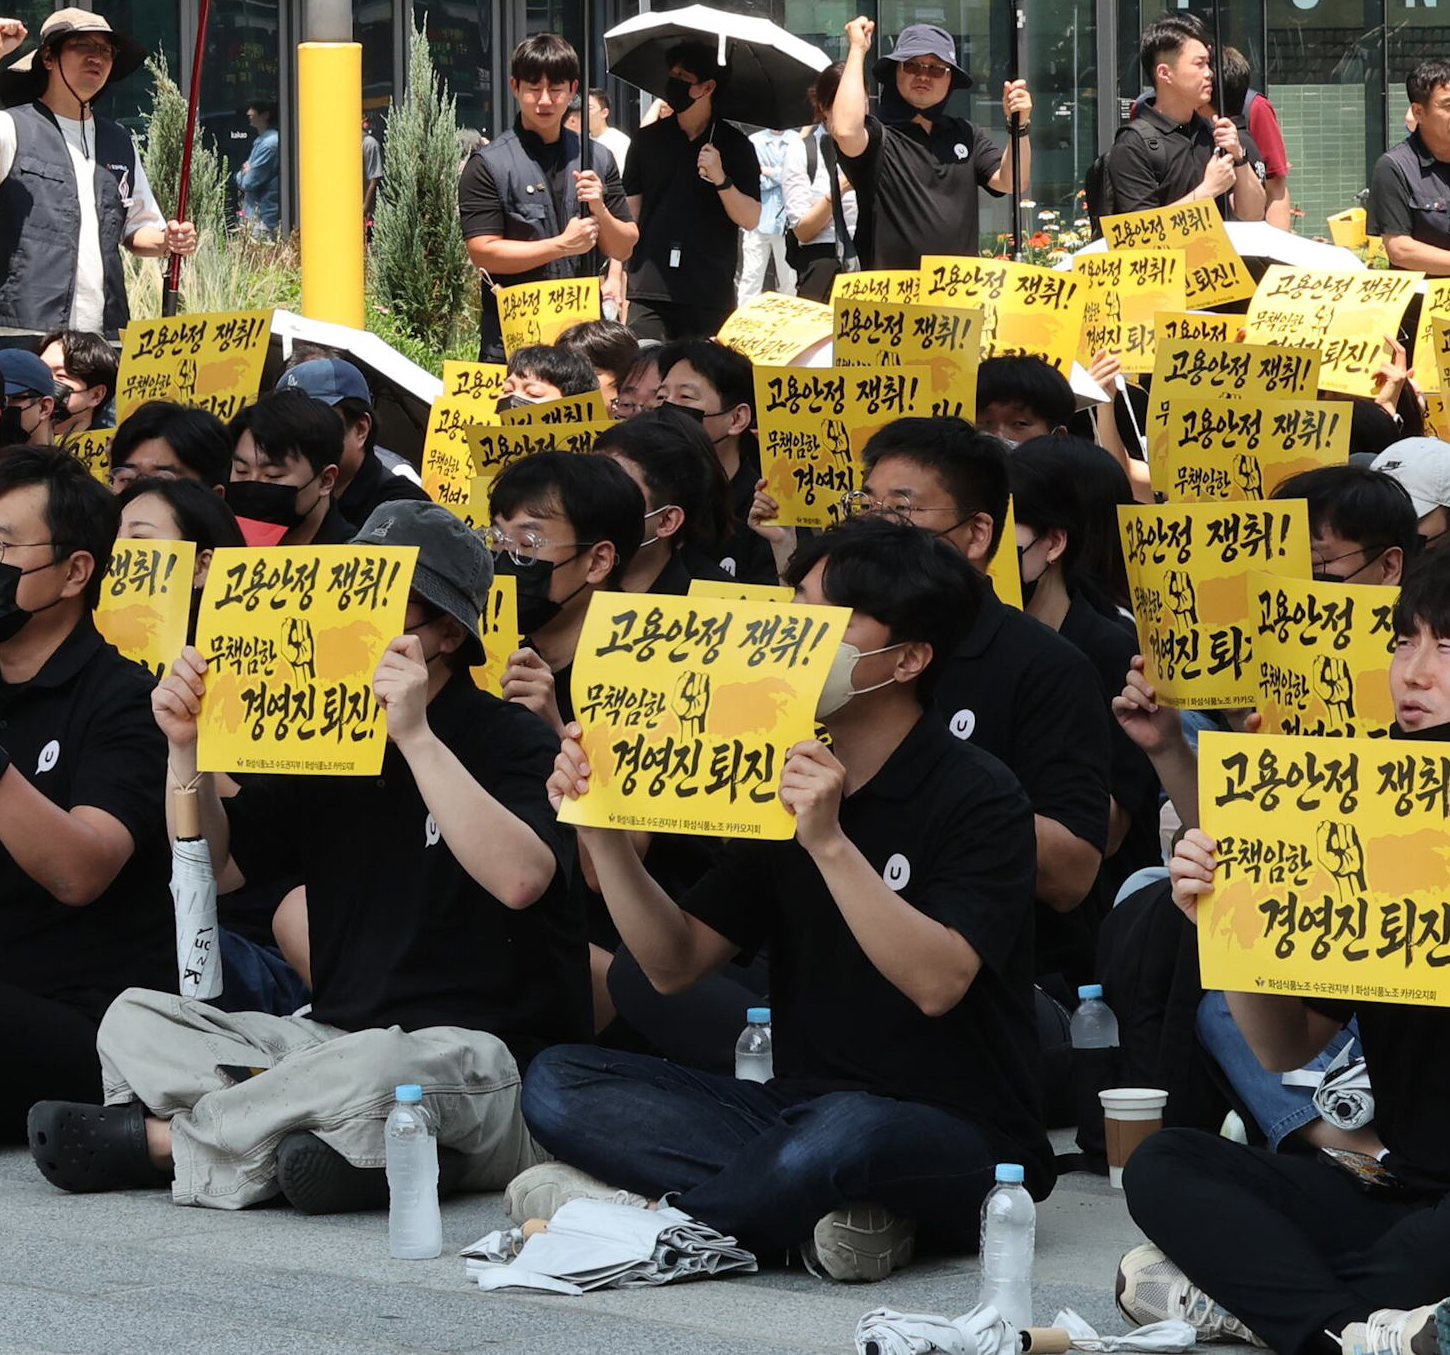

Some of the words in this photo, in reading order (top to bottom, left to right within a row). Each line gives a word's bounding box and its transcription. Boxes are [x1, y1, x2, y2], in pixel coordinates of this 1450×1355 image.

[503, 289, 540, 321] 고용안정
[549, 286, 589, 313] 쟁취!
[132, 321, 207, 360] 고용안정
[213, 318, 264, 352] 쟁취!
[766, 375, 844, 414] 고용안정
[856, 375, 918, 414] 쟁취!
[1178, 408, 1262, 450] 고용안정
[1272, 410, 1339, 450] 쟁취!
[215, 558, 320, 611] 고용안정
[327, 557, 400, 611] 쟁취!
[200, 636, 277, 681] 무책임한
[596, 607, 732, 665] 고용안정
[739, 615, 829, 668] 쟁취!
[241, 681, 316, 741] 경영진
[320, 683, 373, 743] 퇴진!
[580, 684, 665, 729] 무책임한
[612, 734, 702, 798] 경영진
[702, 735, 777, 806] 퇴진
[1215, 749, 1358, 814] 고용안정
[1210, 837, 1312, 886] 무책임한
[1259, 892, 1369, 961] 경영진
